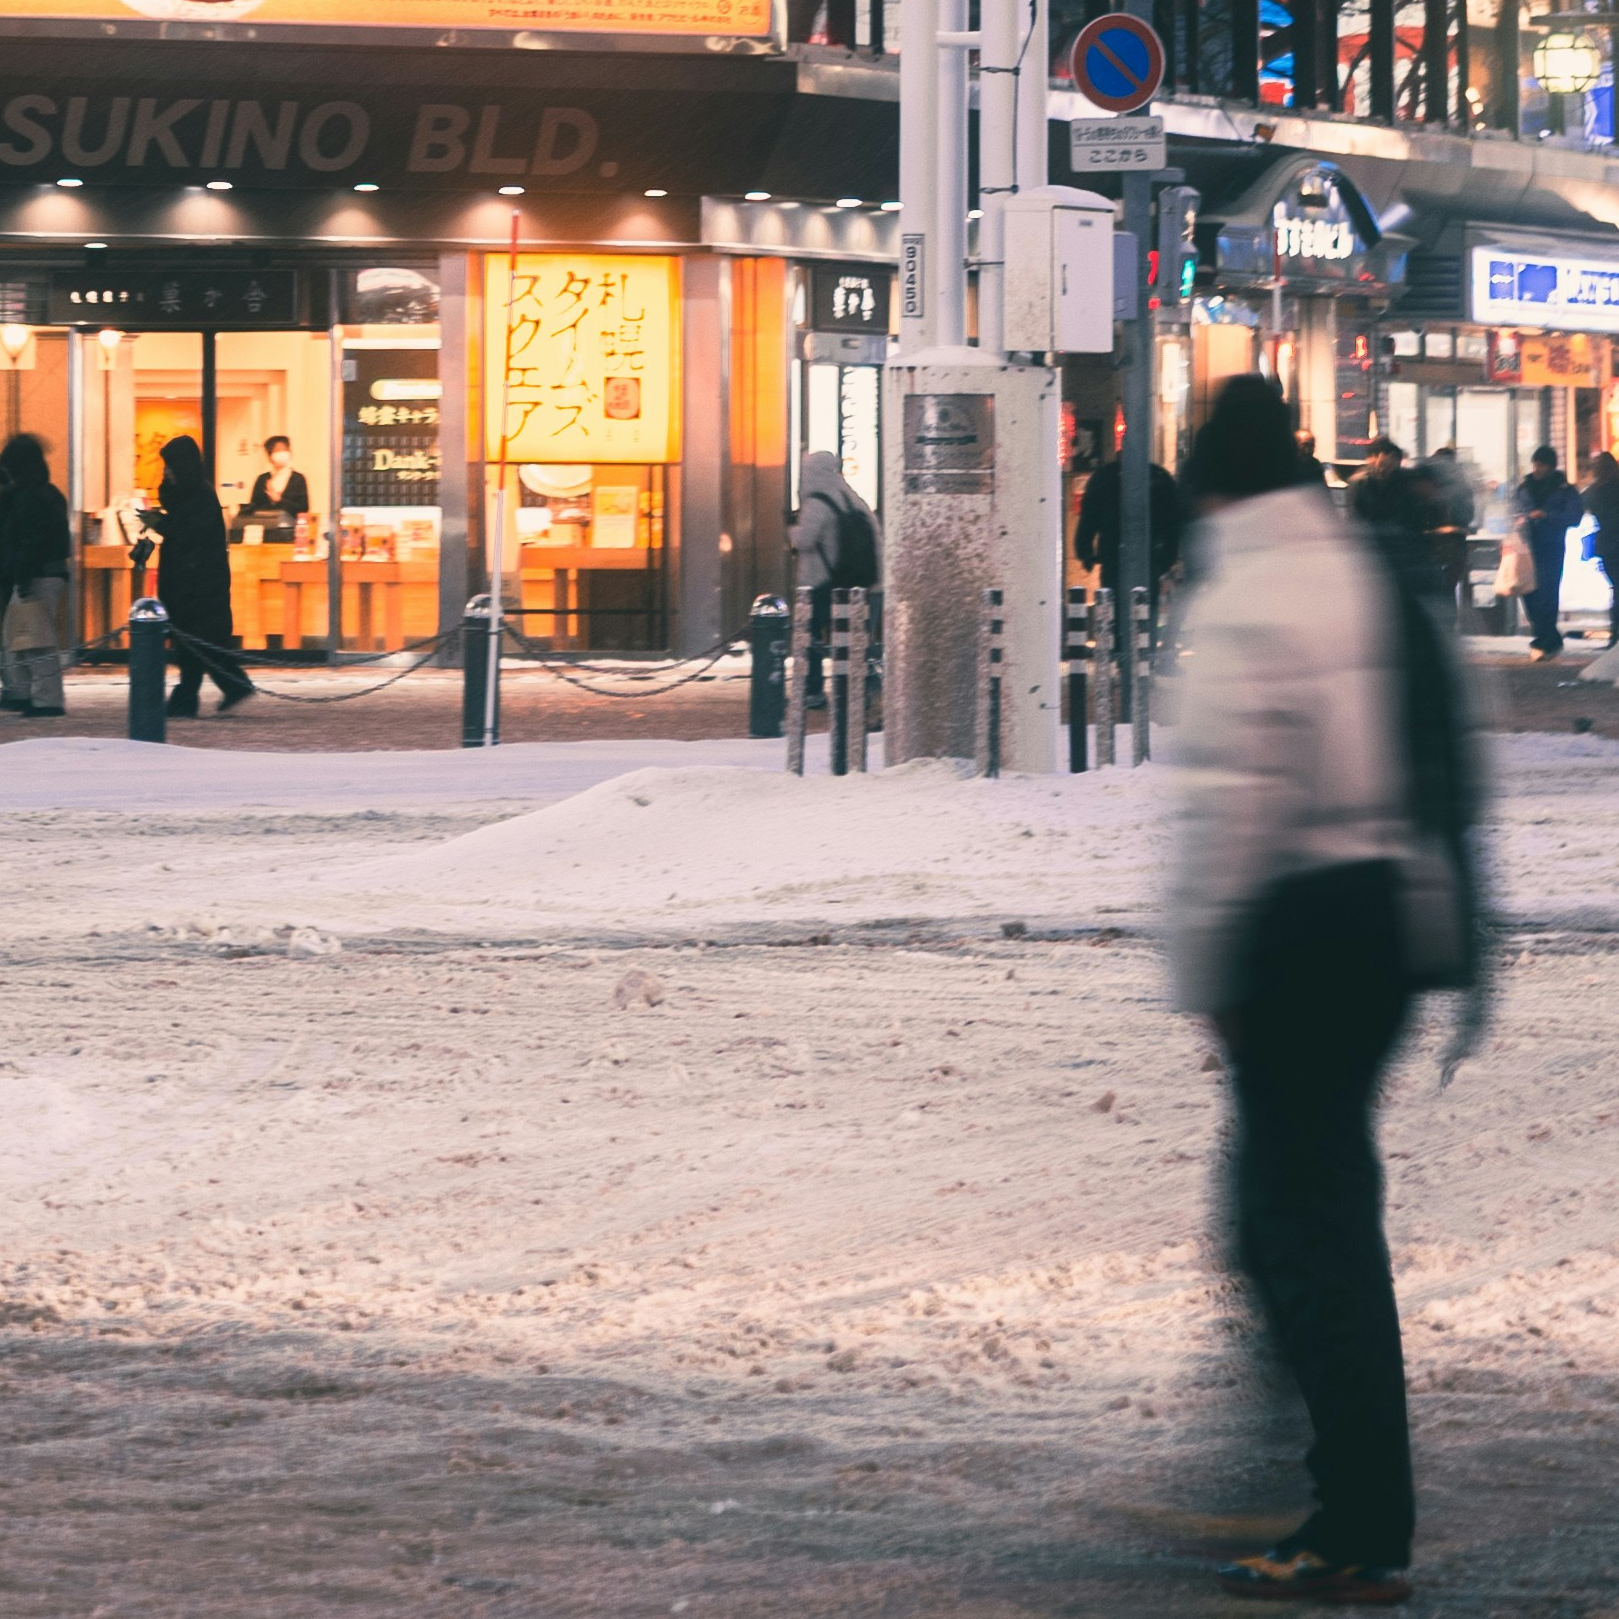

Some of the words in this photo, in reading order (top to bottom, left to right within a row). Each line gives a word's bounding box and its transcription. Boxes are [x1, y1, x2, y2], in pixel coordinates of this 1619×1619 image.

[406, 102, 619, 177] BLD.
[549, 271, 599, 437] タイムズ
[597, 272, 645, 371] 札幌
